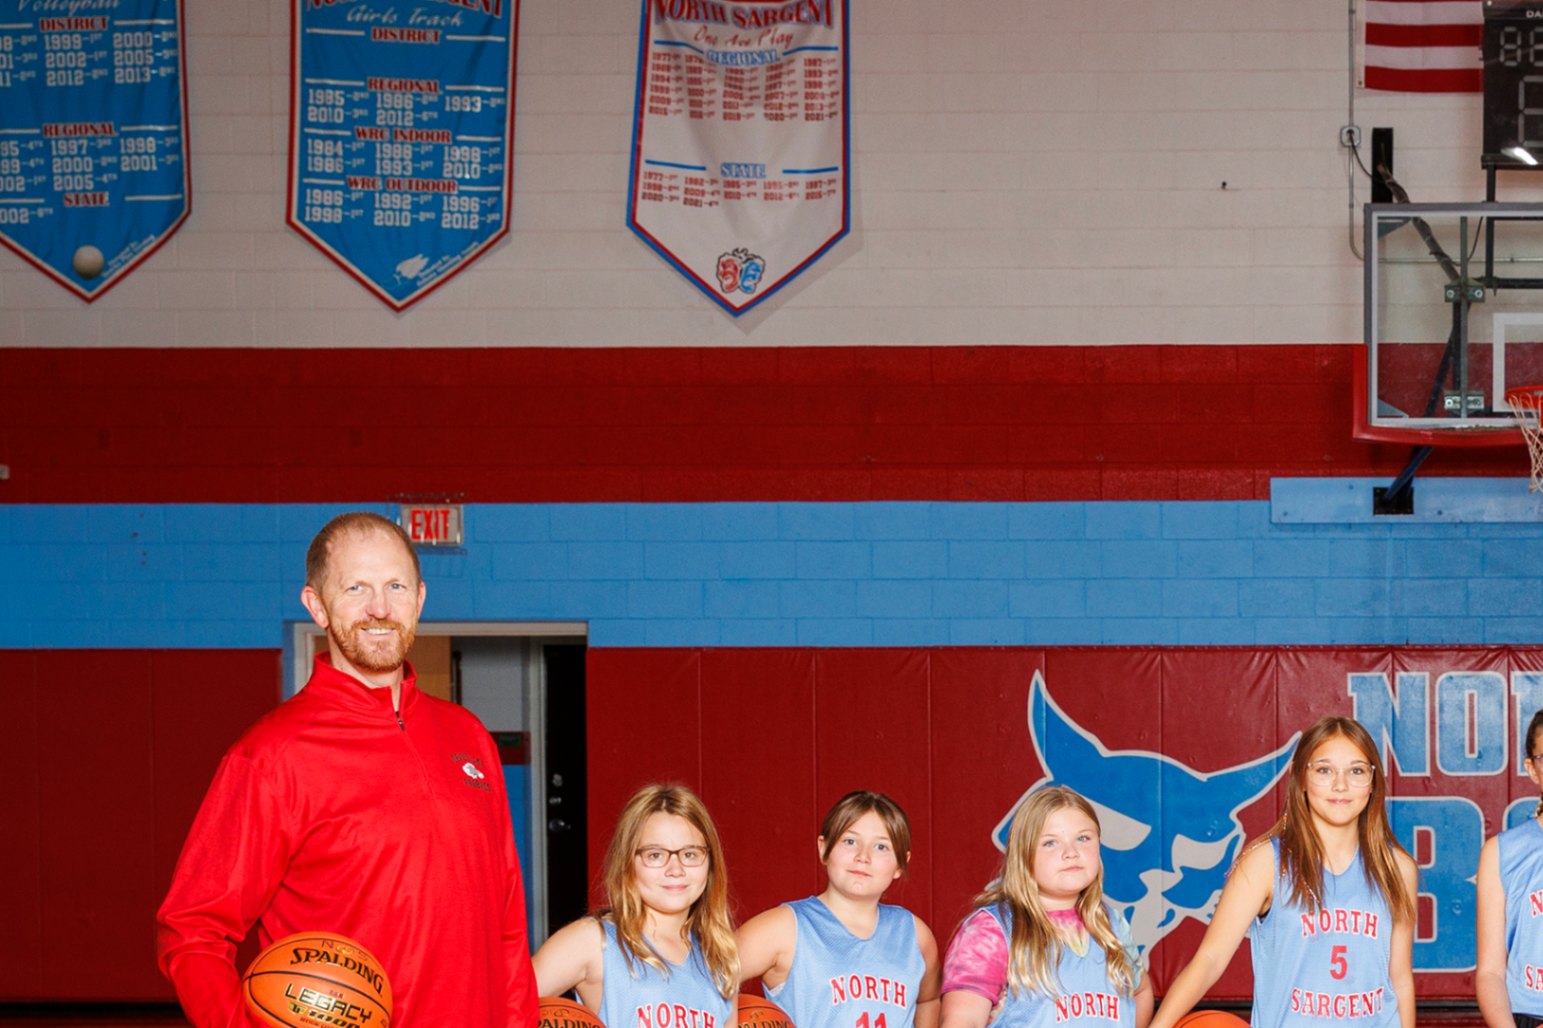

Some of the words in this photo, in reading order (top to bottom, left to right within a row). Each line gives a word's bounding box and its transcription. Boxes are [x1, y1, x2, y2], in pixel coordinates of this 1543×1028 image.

[39, 16, 110, 32] DISTRICT
[347, 4, 398, 23] Girls
[408, 8, 463, 27] Track
[732, 0, 834, 30] SARGENT
[371, 26, 442, 44] DISTRICT
[367, 77, 442, 94] REGIONAL
[42, 122, 119, 138] REGIONAL
[355, 126, 389, 140] WRC
[393, 129, 452, 144] INDOOR
[720, 162, 767, 179] STATE
[347, 176, 381, 190] WRC
[385, 178, 458, 194] OUTDOOR
[64, 191, 110, 207] STATE
[411, 509, 450, 540] EXIT
[1301, 908, 1378, 938] NORTH
[290, 948, 384, 994] SPALDING
[1330, 945, 1348, 980] 5
[285, 983, 372, 1024] LEGACY
[830, 973, 907, 1008] NORTH
[1291, 987, 1384, 1018] SARGENT
[1055, 991, 1119, 1021] NORTH
